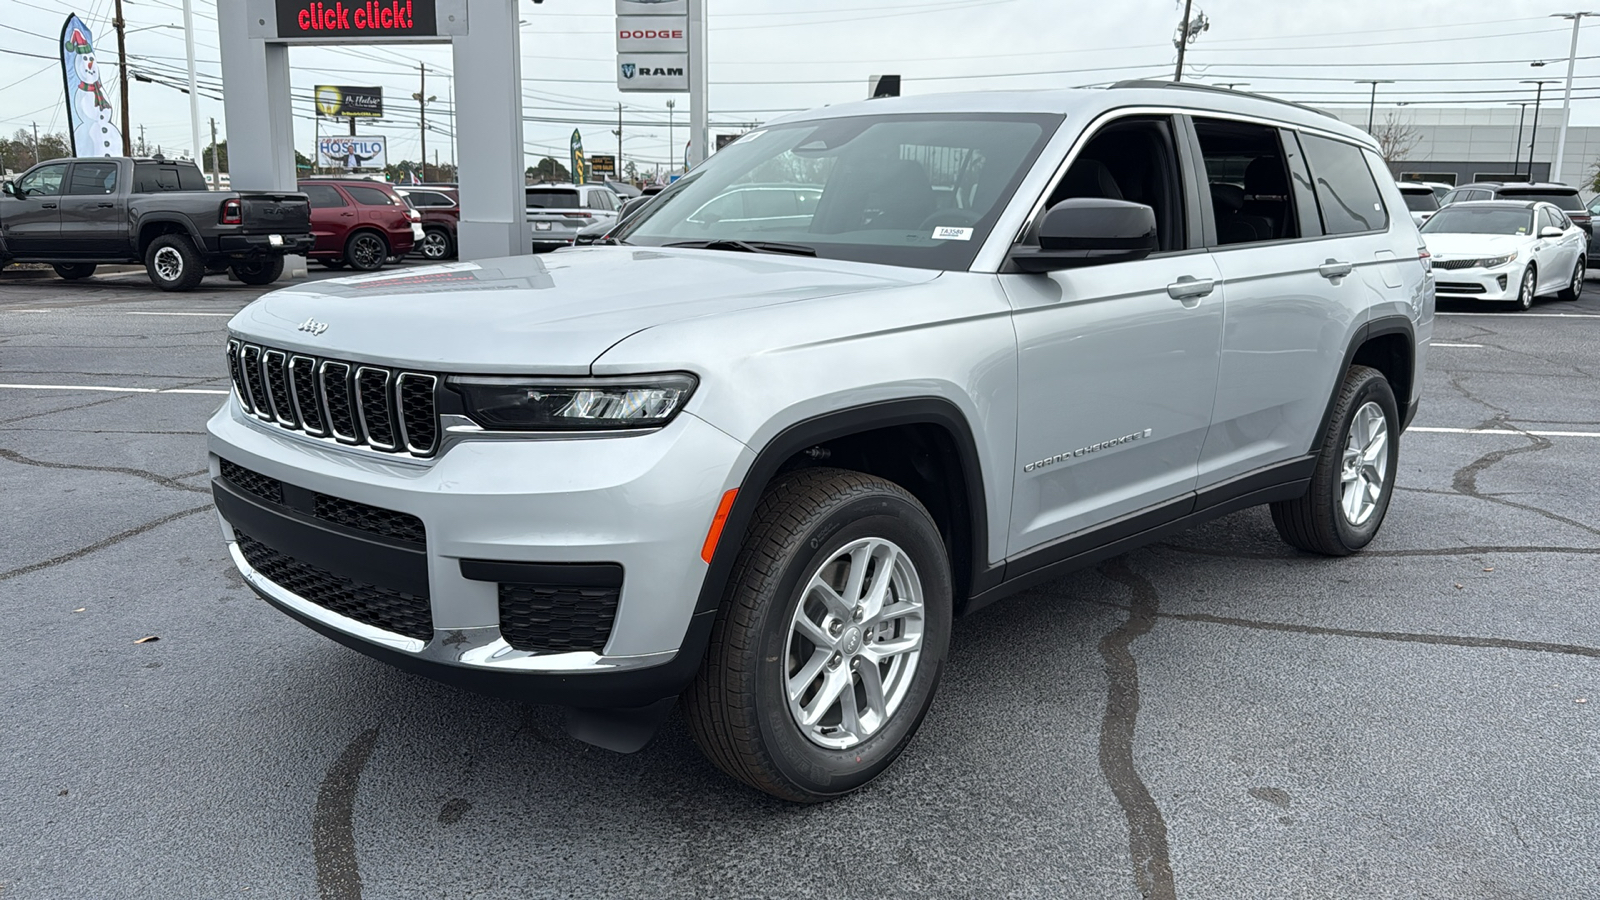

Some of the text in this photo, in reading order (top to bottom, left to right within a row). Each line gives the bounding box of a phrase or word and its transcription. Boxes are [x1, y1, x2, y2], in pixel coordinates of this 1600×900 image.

[298, 0, 414, 30] click click!
[619, 30, 683, 39] DODGE
[638, 67, 684, 76] RAM
[320, 142, 382, 154] HOSTILO
[297, 317, 330, 337] Jeep
[1024, 451, 1072, 473] GRAND
[1073, 431, 1141, 458] CHEROKEE
